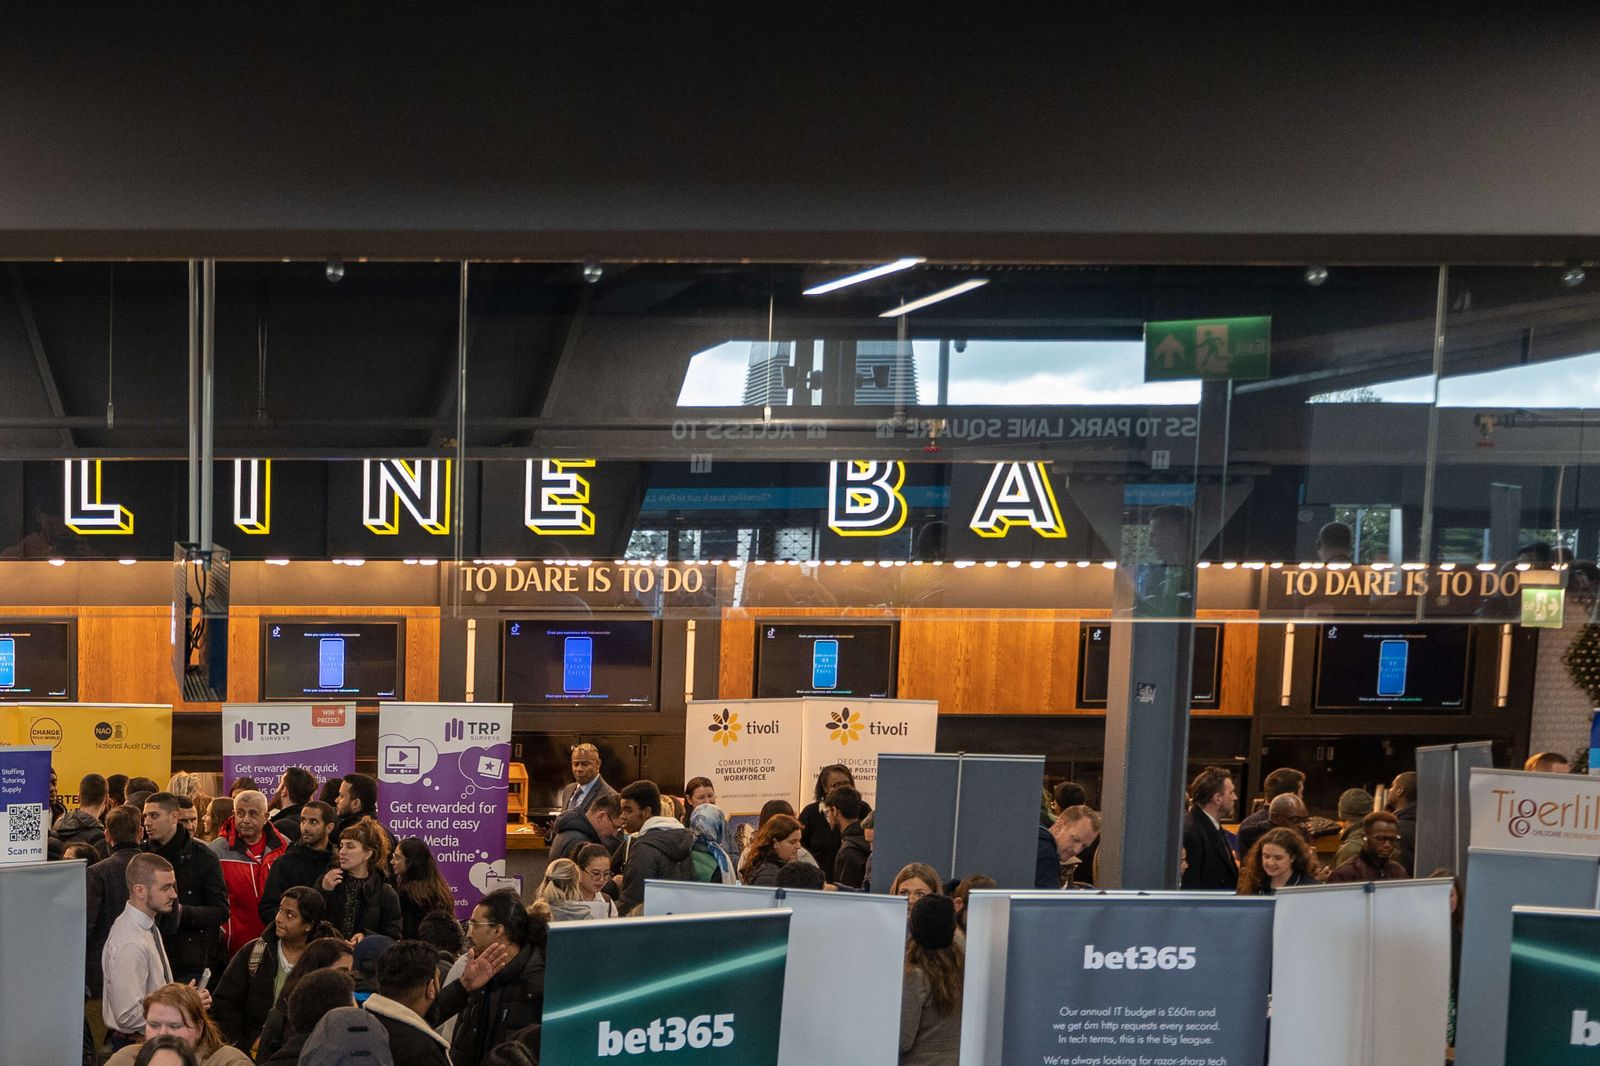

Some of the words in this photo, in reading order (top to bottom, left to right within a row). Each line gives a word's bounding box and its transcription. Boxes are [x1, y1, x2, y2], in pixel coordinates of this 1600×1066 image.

[827, 459, 1068, 538] BA
[460, 567, 498, 592] TO
[505, 567, 580, 593] DARE
[587, 567, 612, 592] IS
[618, 567, 656, 592] TO
[662, 567, 703, 593] DO
[1282, 570, 1319, 596] TO
[1325, 570, 1399, 597] DARE
[1404, 570, 1429, 596] IS
[1437, 571, 1473, 597] TO
[1479, 571, 1520, 598] DO
[317, 716, 340, 724] PRIZES!
[257, 722, 290, 735] TRP
[467, 721, 500, 734] TRP
[746, 720, 780, 735] tivoli
[869, 721, 908, 737] tivoli
[718, 758, 761, 766] COMMITTED
[1, 768, 25, 776] Staffing
[235, 763, 252, 773] Get
[314, 763, 338, 774] quick
[715, 766, 759, 775] DEVELOPING
[759, 765, 776, 773] OUR
[2, 777, 26, 785] Tutoring
[254, 776, 274, 785] easy
[723, 773, 767, 782] WORKFORCE
[1, 786, 22, 794] Supply
[390, 801, 413, 813] Get
[416, 801, 477, 814] rewarded
[479, 801, 497, 814] for
[1492, 789, 1600, 838] Tigerlil
[389, 816, 419, 832] quick
[423, 816, 448, 829] and
[452, 820, 480, 832] easy
[424, 834, 459, 847] Media
[7, 846, 31, 856] Scan
[33, 847, 43, 855] me
[437, 850, 475, 862] online
[1083, 945, 1197, 970] bet365
[1059, 1007, 1079, 1016] Our
[1080, 1007, 1111, 1016] annual
[1124, 1007, 1156, 1019] budget
[1167, 1007, 1195, 1017] £60m
[1197, 1007, 1216, 1017] and
[1067, 1021, 1082, 1032] get
[1120, 1021, 1157, 1033] requests
[1159, 1023, 1183, 1032] every
[1185, 1021, 1221, 1031] second.
[597, 1013, 735, 1057] bet365
[1069, 1035, 1088, 1044] tech
[1089, 1035, 1117, 1045] terms,
[1119, 1035, 1135, 1044] this
[1146, 1035, 1160, 1044] the
[1162, 1034, 1177, 1046] big
[1179, 1035, 1214, 1046] league.
[1071, 1056, 1101, 1066] always
[1102, 1055, 1137, 1066] looking
[1208, 1056, 1227, 1066] tech
